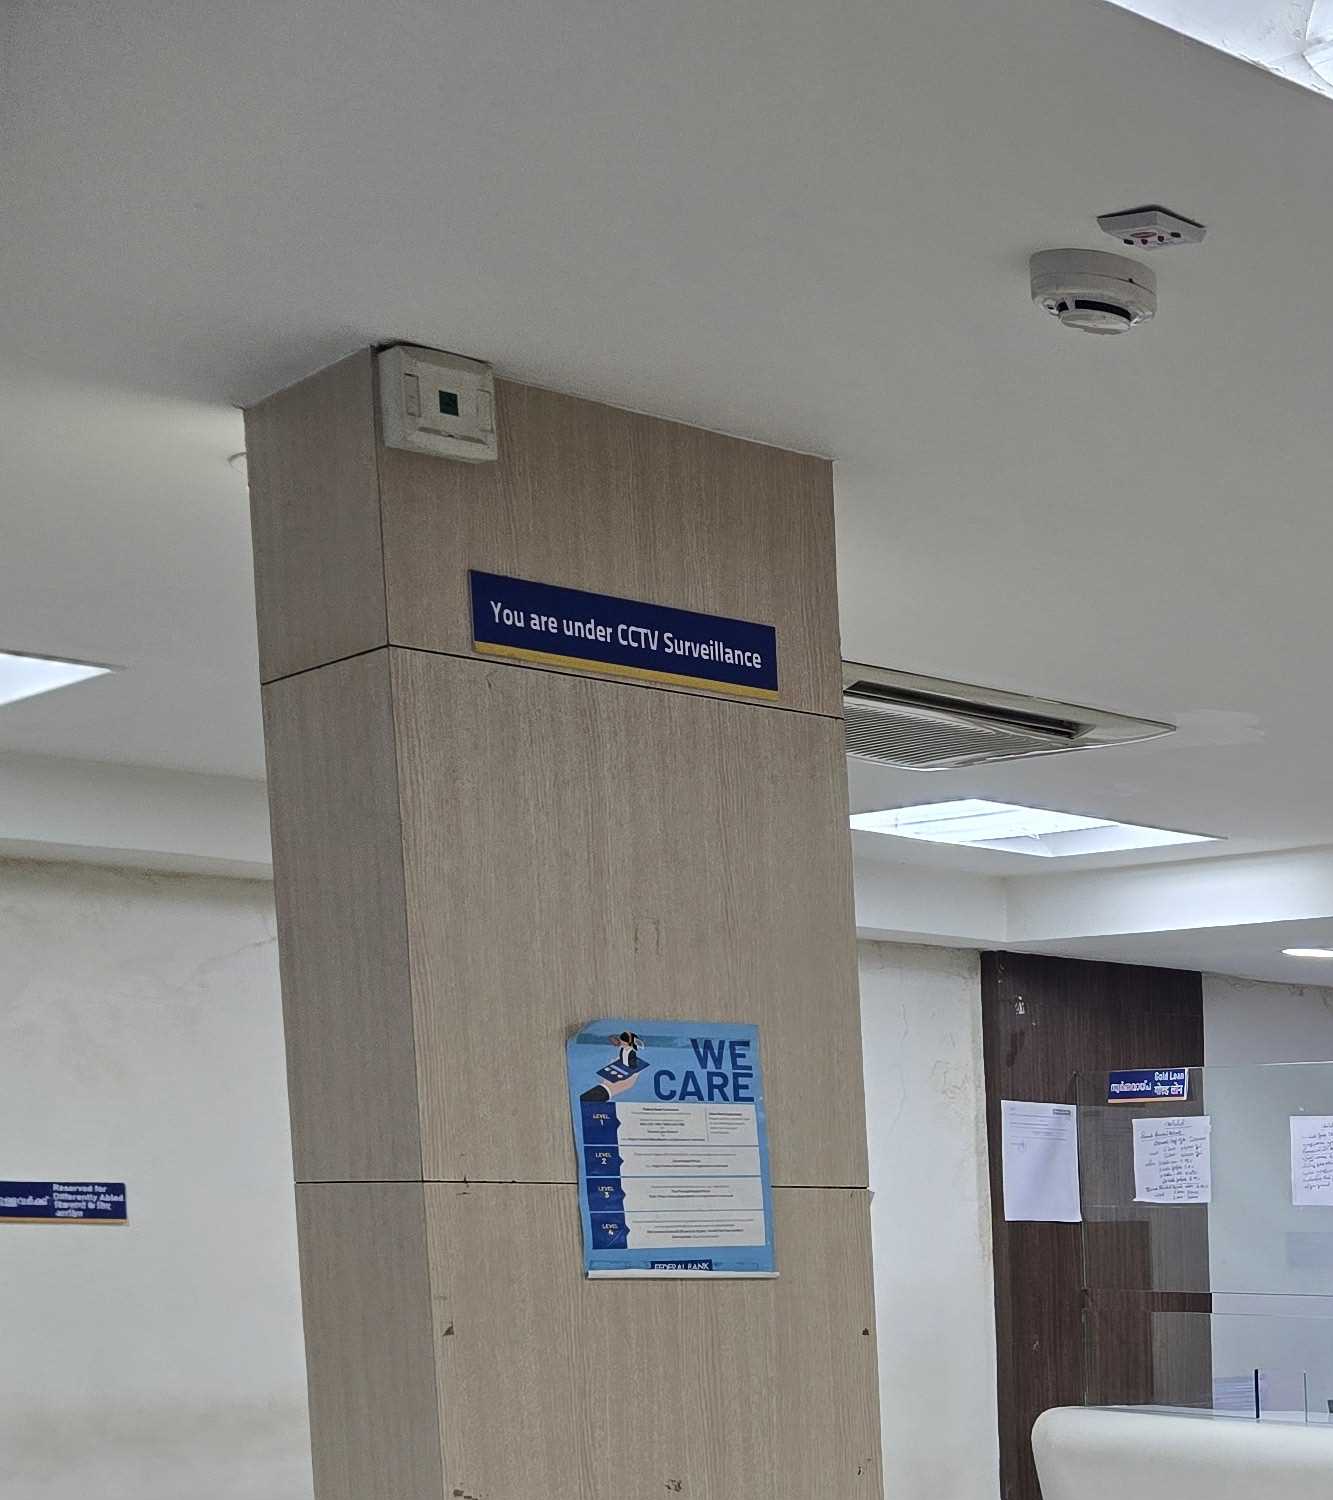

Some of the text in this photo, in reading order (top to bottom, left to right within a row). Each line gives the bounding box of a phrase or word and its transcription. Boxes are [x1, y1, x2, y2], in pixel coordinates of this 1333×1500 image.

[490, 600, 762, 669] You are under CCTV Surveillance
[690, 1037, 753, 1071] WE
[653, 1070, 755, 1103] CARE
[1154, 1071, 1184, 1081] Gold Loan
